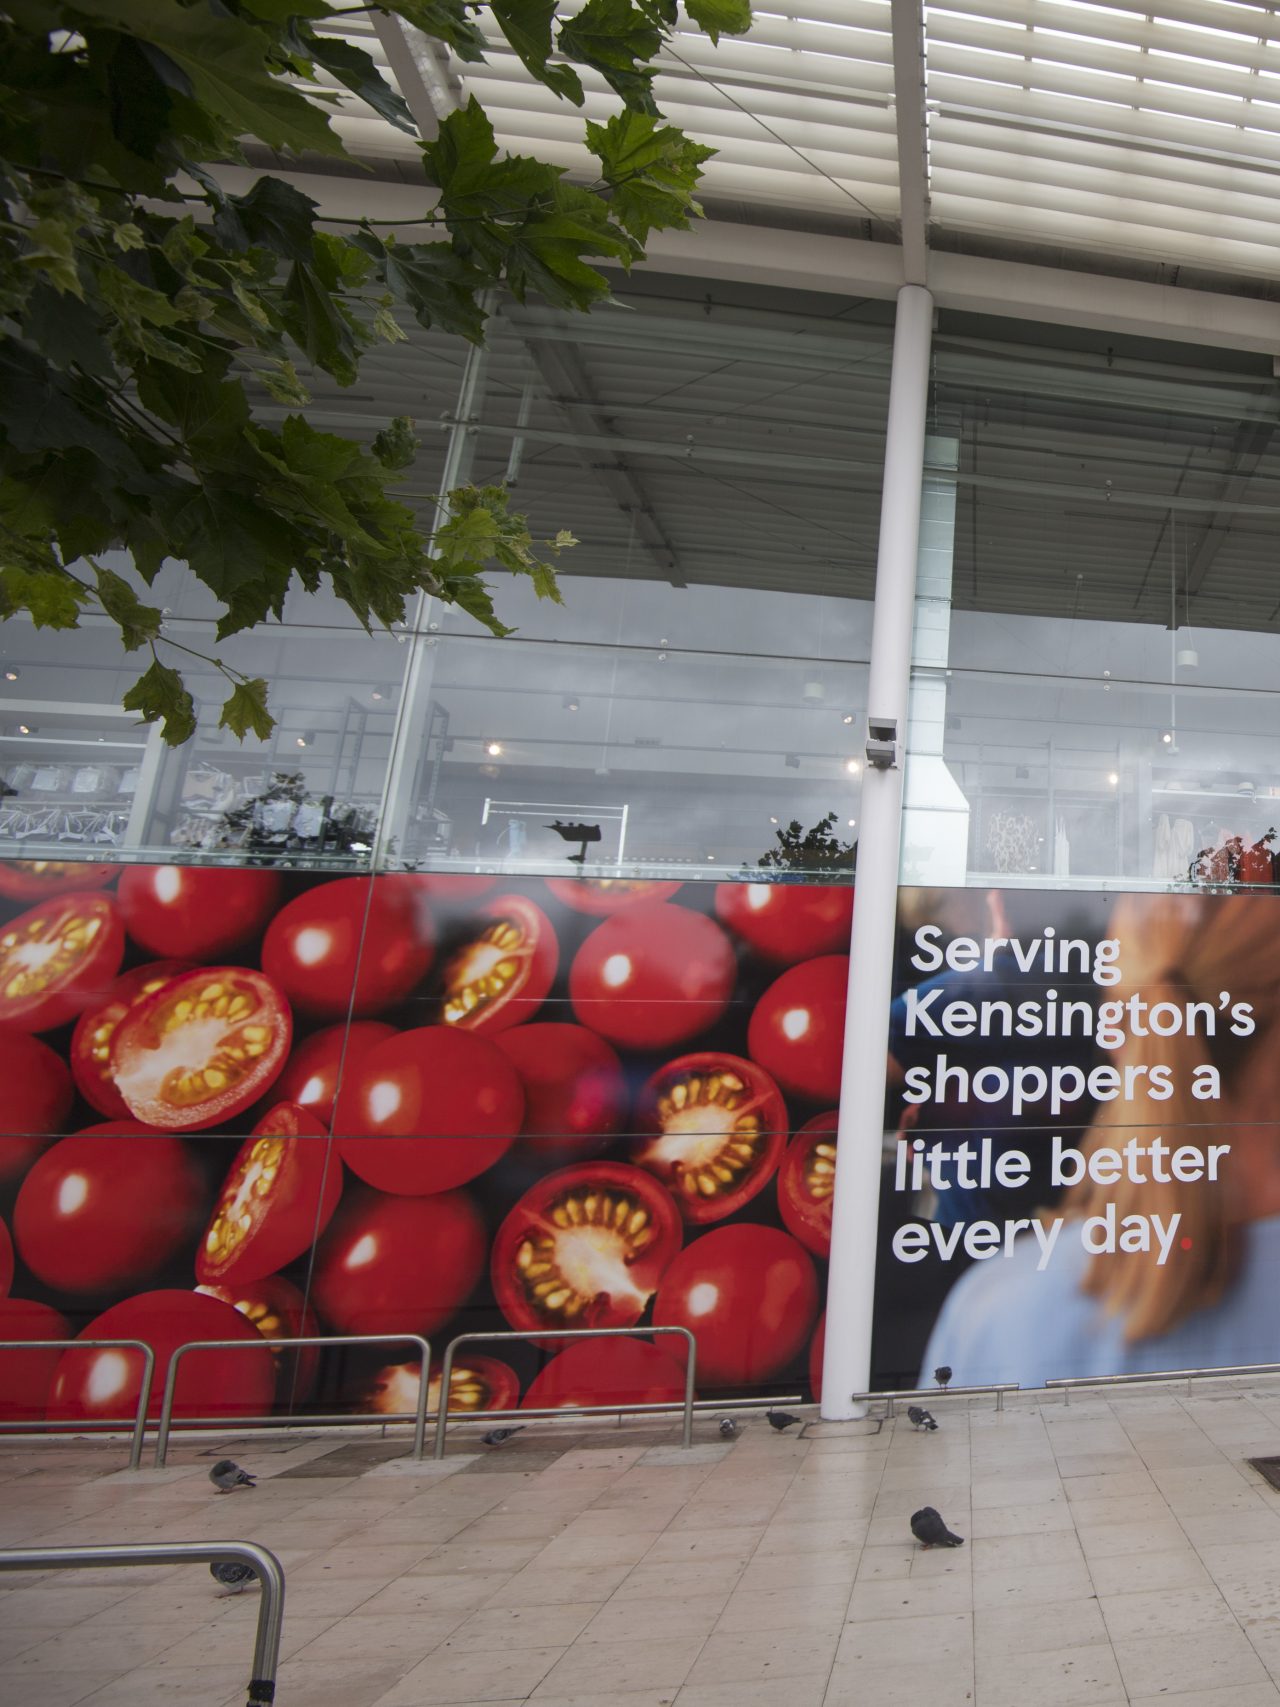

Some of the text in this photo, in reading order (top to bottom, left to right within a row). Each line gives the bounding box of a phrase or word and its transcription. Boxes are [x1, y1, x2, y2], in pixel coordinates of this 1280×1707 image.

[910, 924, 1122, 986] Serving
[903, 989, 1255, 1049] Kensington's
[902, 1055, 1221, 1116] shoppers a
[894, 1136, 1230, 1191] little better
[892, 1204, 1193, 1271] every day.
